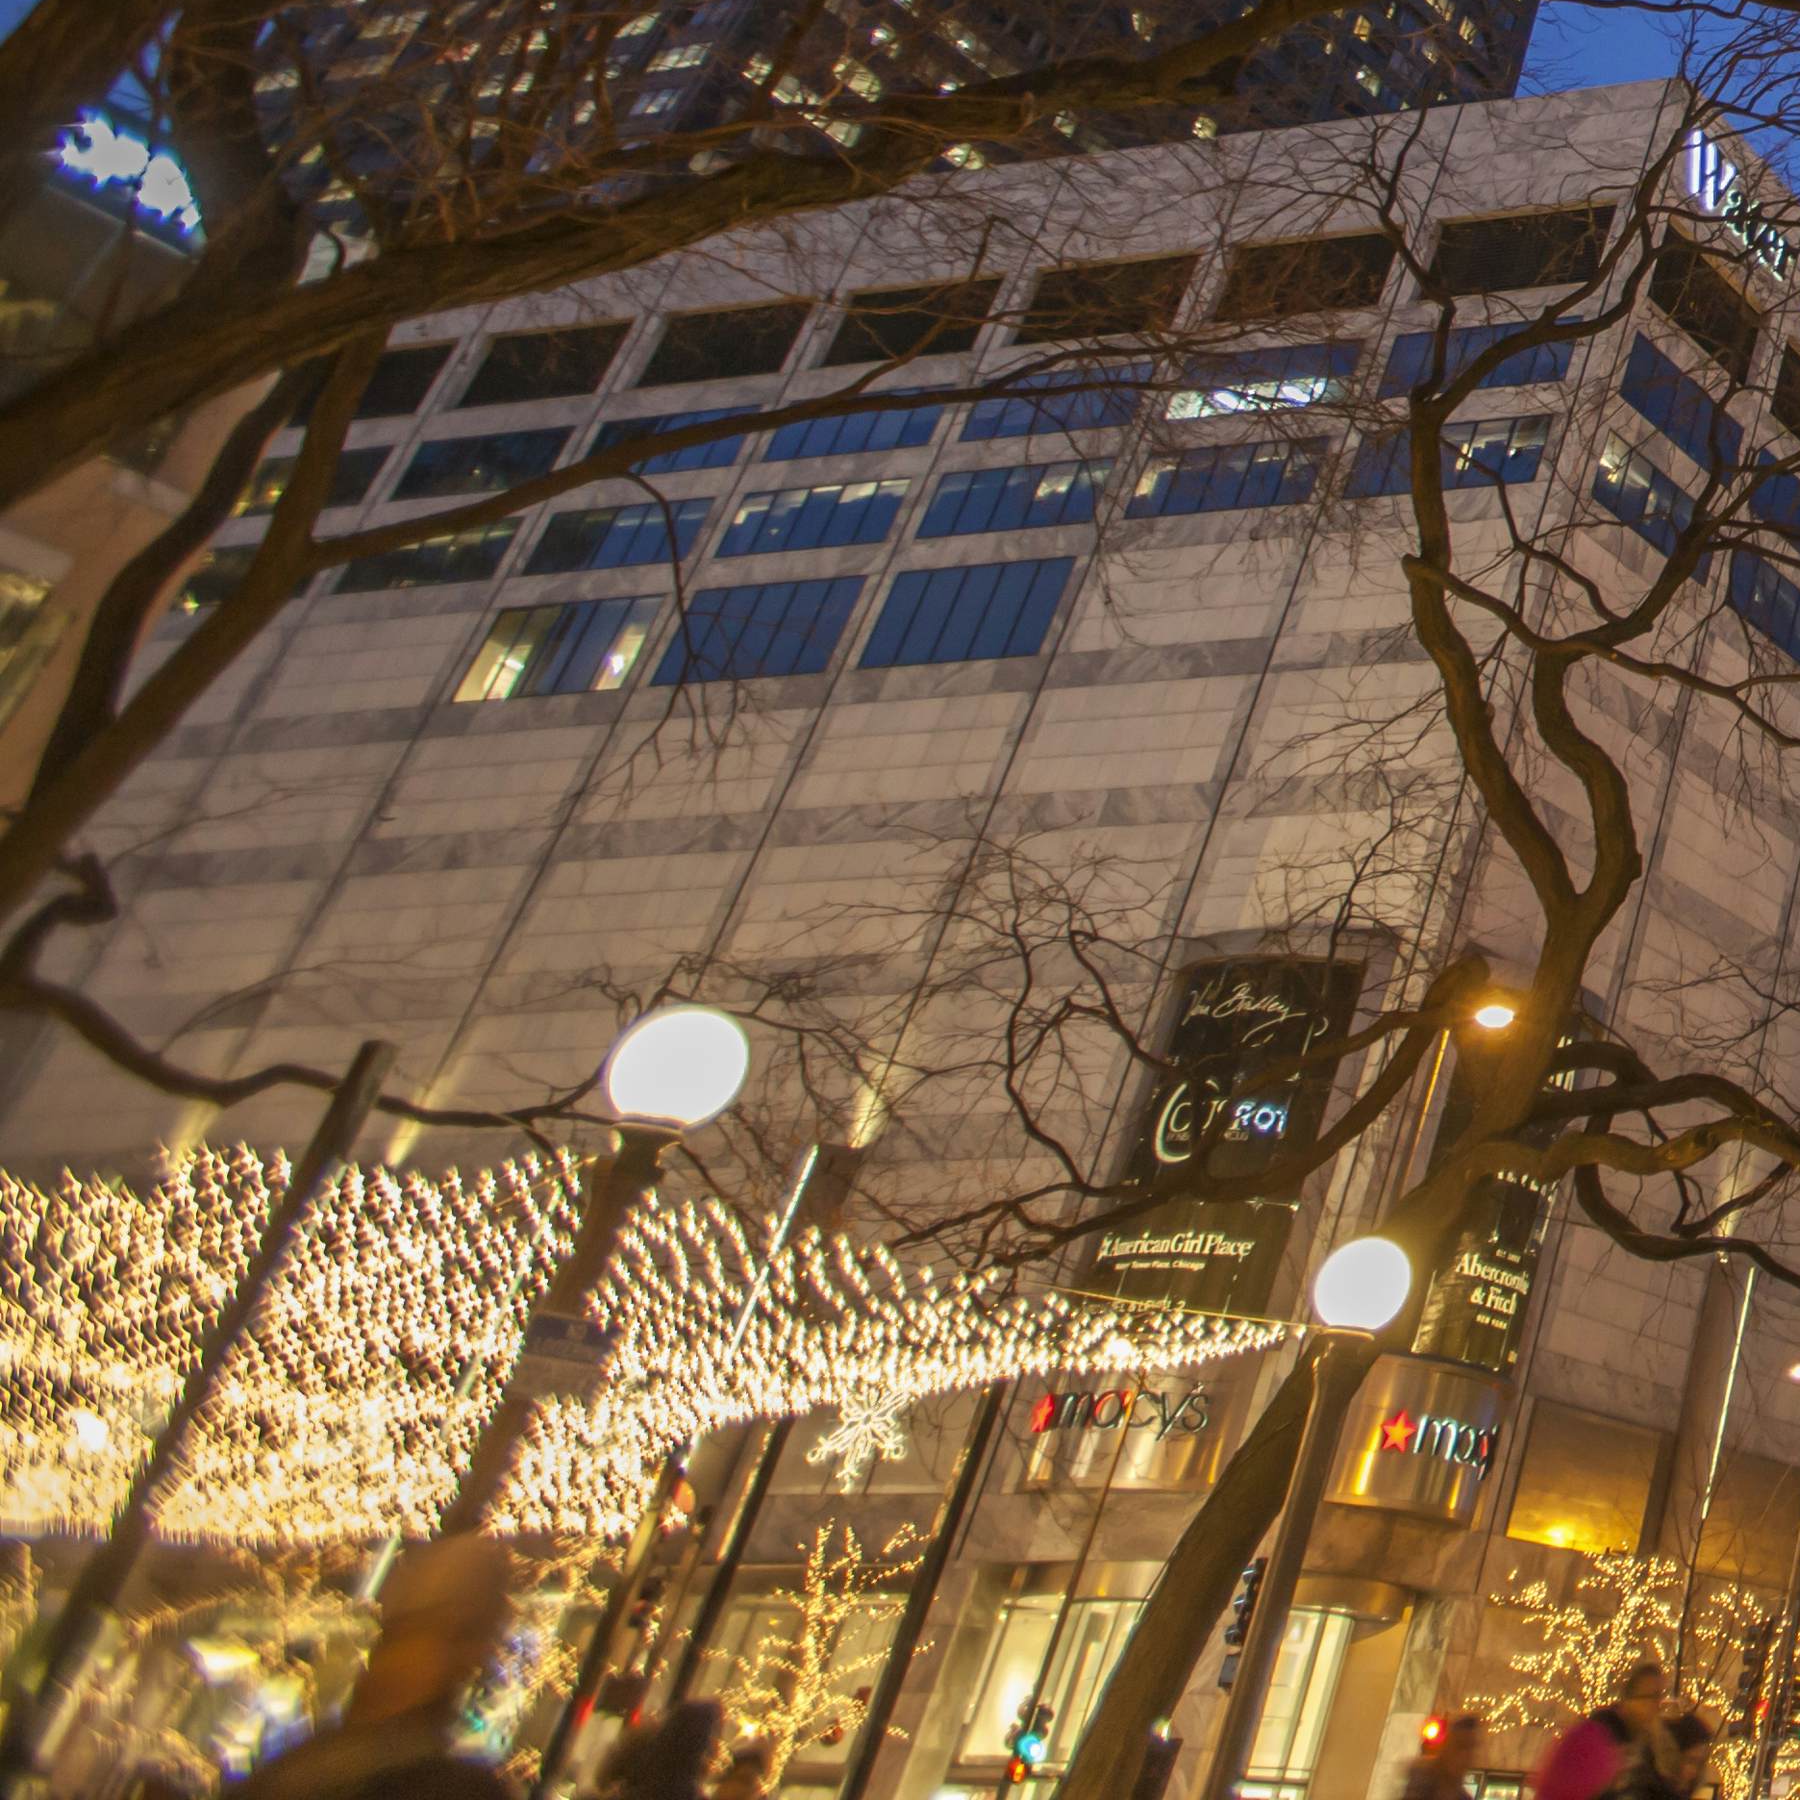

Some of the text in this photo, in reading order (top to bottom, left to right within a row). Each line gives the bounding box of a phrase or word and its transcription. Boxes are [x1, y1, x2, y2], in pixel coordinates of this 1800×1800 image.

[1111, 1230, 1254, 1258] American Girl Place
[1470, 1286, 1486, 1305] &
